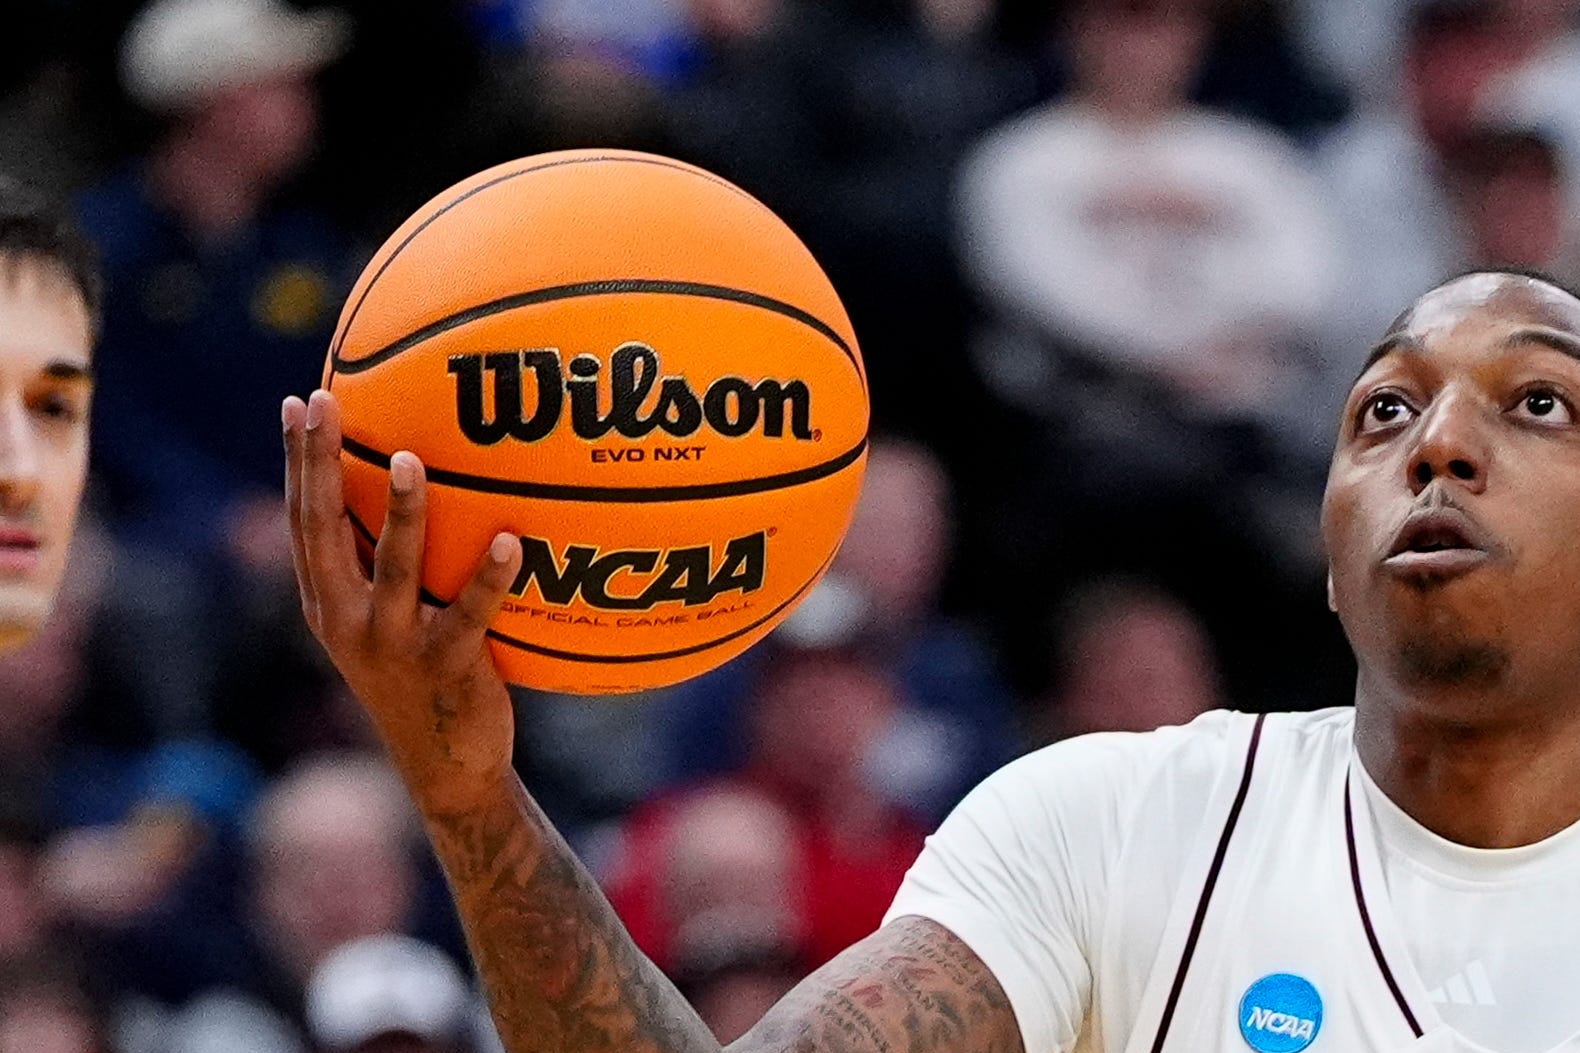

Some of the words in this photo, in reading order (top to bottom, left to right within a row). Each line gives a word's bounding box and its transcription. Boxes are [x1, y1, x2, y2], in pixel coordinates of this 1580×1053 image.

[447, 341, 813, 446] Wilson
[591, 448, 645, 463] EVO
[654, 446, 706, 461] NXT
[508, 529, 767, 612] NCAA
[616, 615, 688, 627] GAME
[697, 601, 755, 620] BALL
[1246, 1006, 1315, 1041] NCAA
